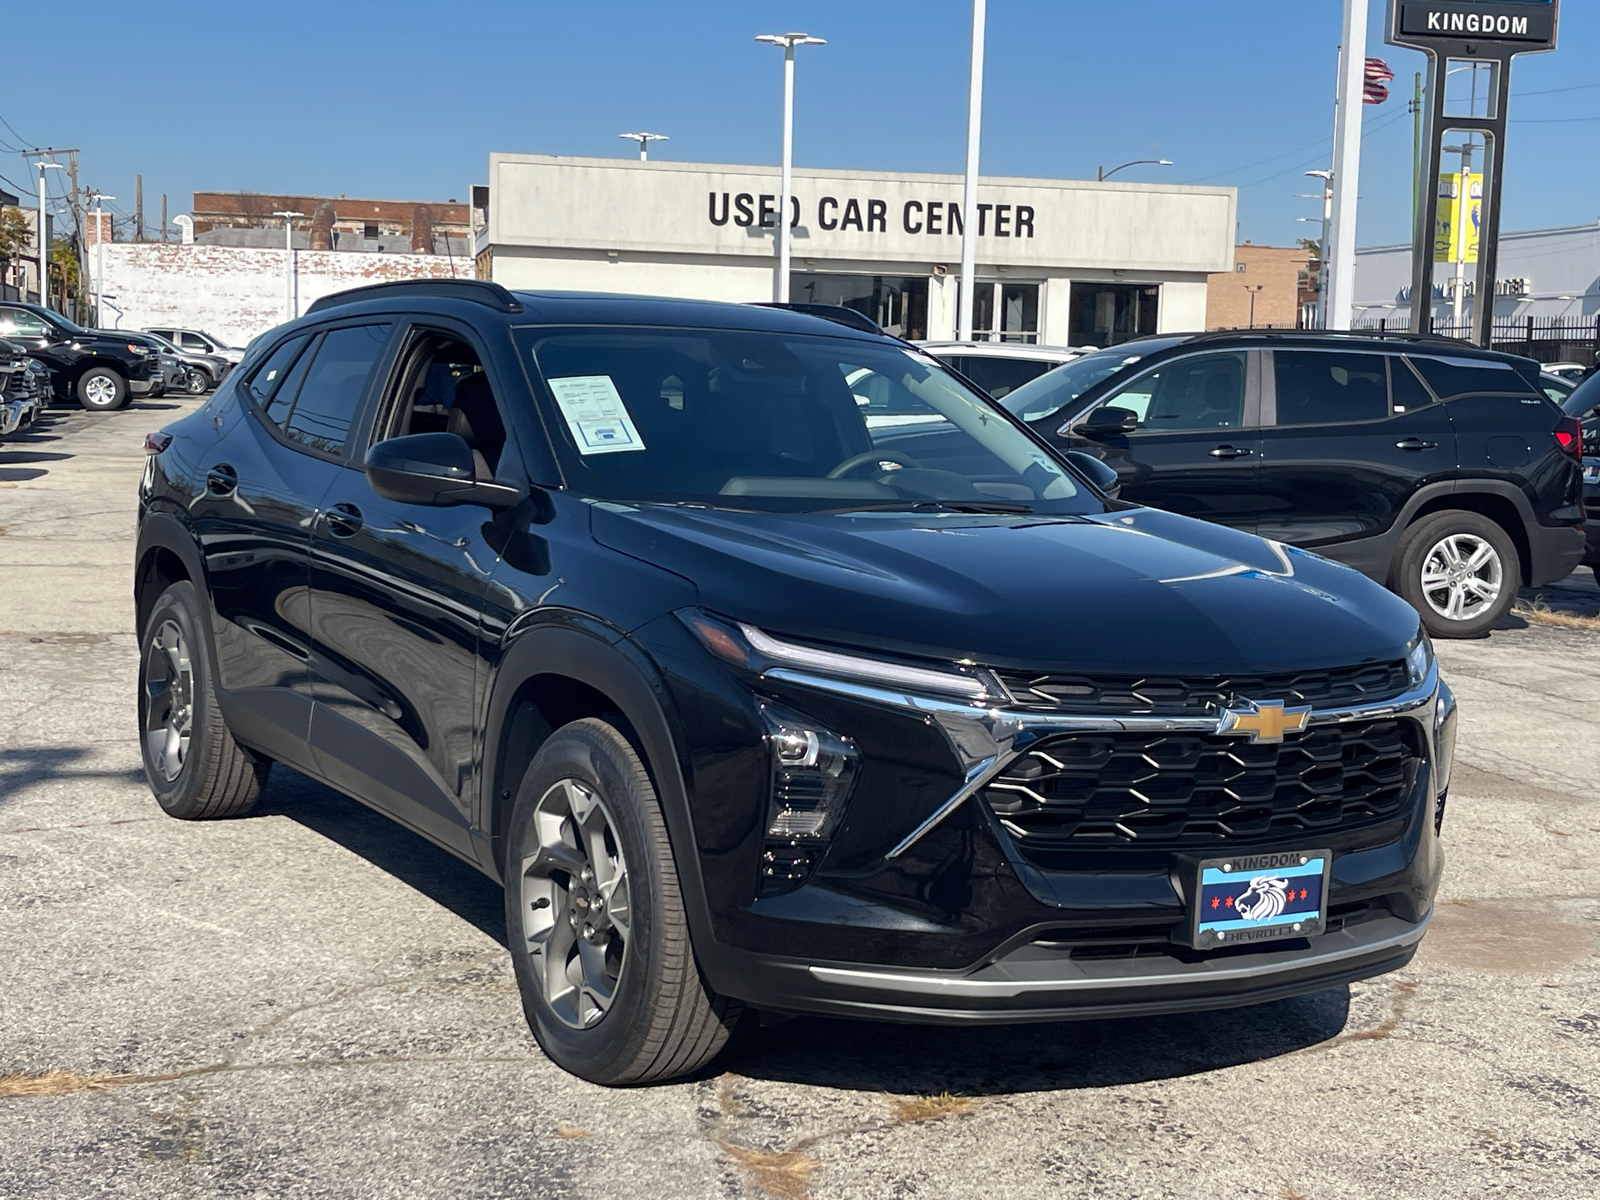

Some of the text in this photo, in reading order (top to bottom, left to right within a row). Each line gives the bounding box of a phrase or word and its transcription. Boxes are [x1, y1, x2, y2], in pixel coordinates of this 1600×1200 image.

[1427, 12, 1528, 35] KINGDOM
[708, 192, 1035, 238] USED CAR CENTER
[1231, 853, 1301, 870] KINGDOM
[1223, 926, 1293, 943] CHEVROLET
